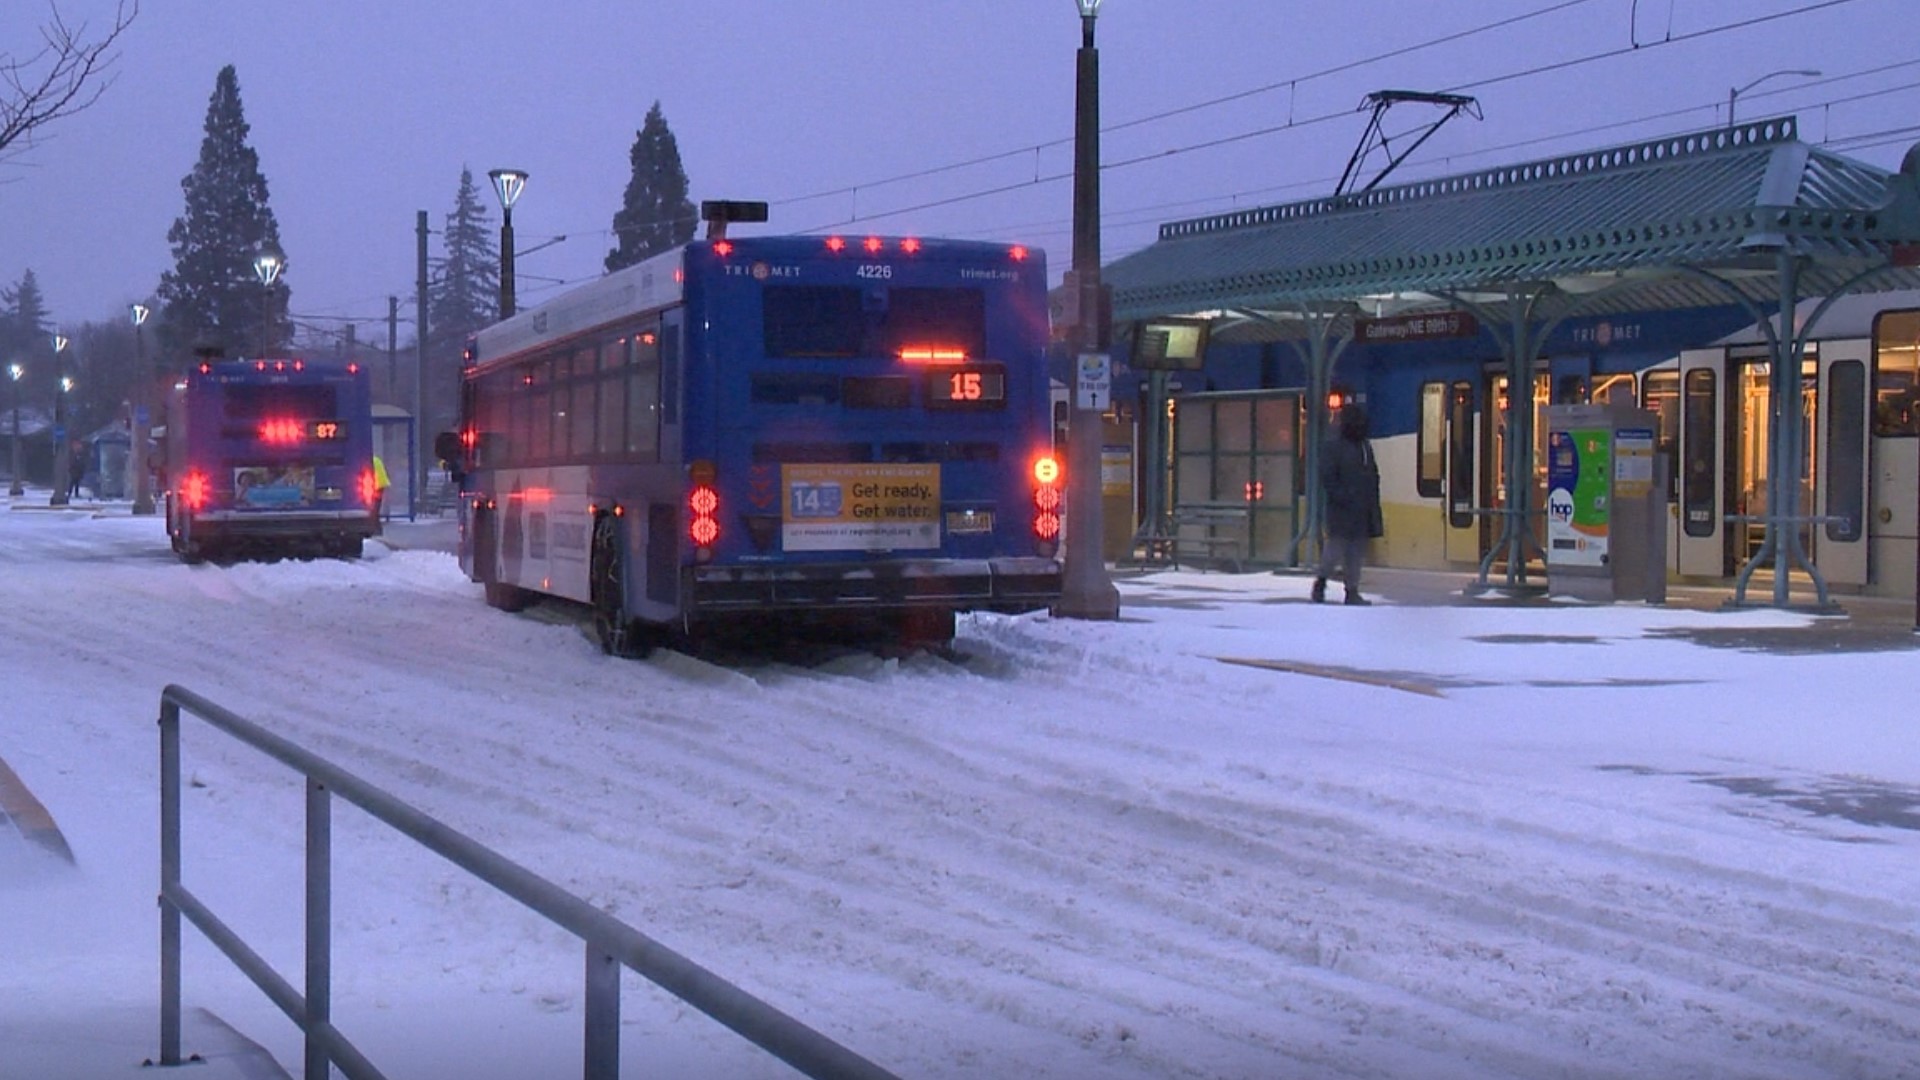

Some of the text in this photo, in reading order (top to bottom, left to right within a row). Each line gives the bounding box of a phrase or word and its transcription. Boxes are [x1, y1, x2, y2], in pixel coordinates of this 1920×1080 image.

[771, 265, 801, 277] MET
[856, 265, 892, 279] 4226
[961, 268, 1019, 281] trimet.org
[1614, 324, 1641, 340] MET
[950, 372, 982, 400] 15
[316, 423, 338, 438] 87
[852, 482, 879, 498] Get
[884, 481, 932, 500] ready.
[793, 488, 820, 512] 14
[852, 503, 931, 518] Get water.
[1551, 497, 1573, 522] hop
